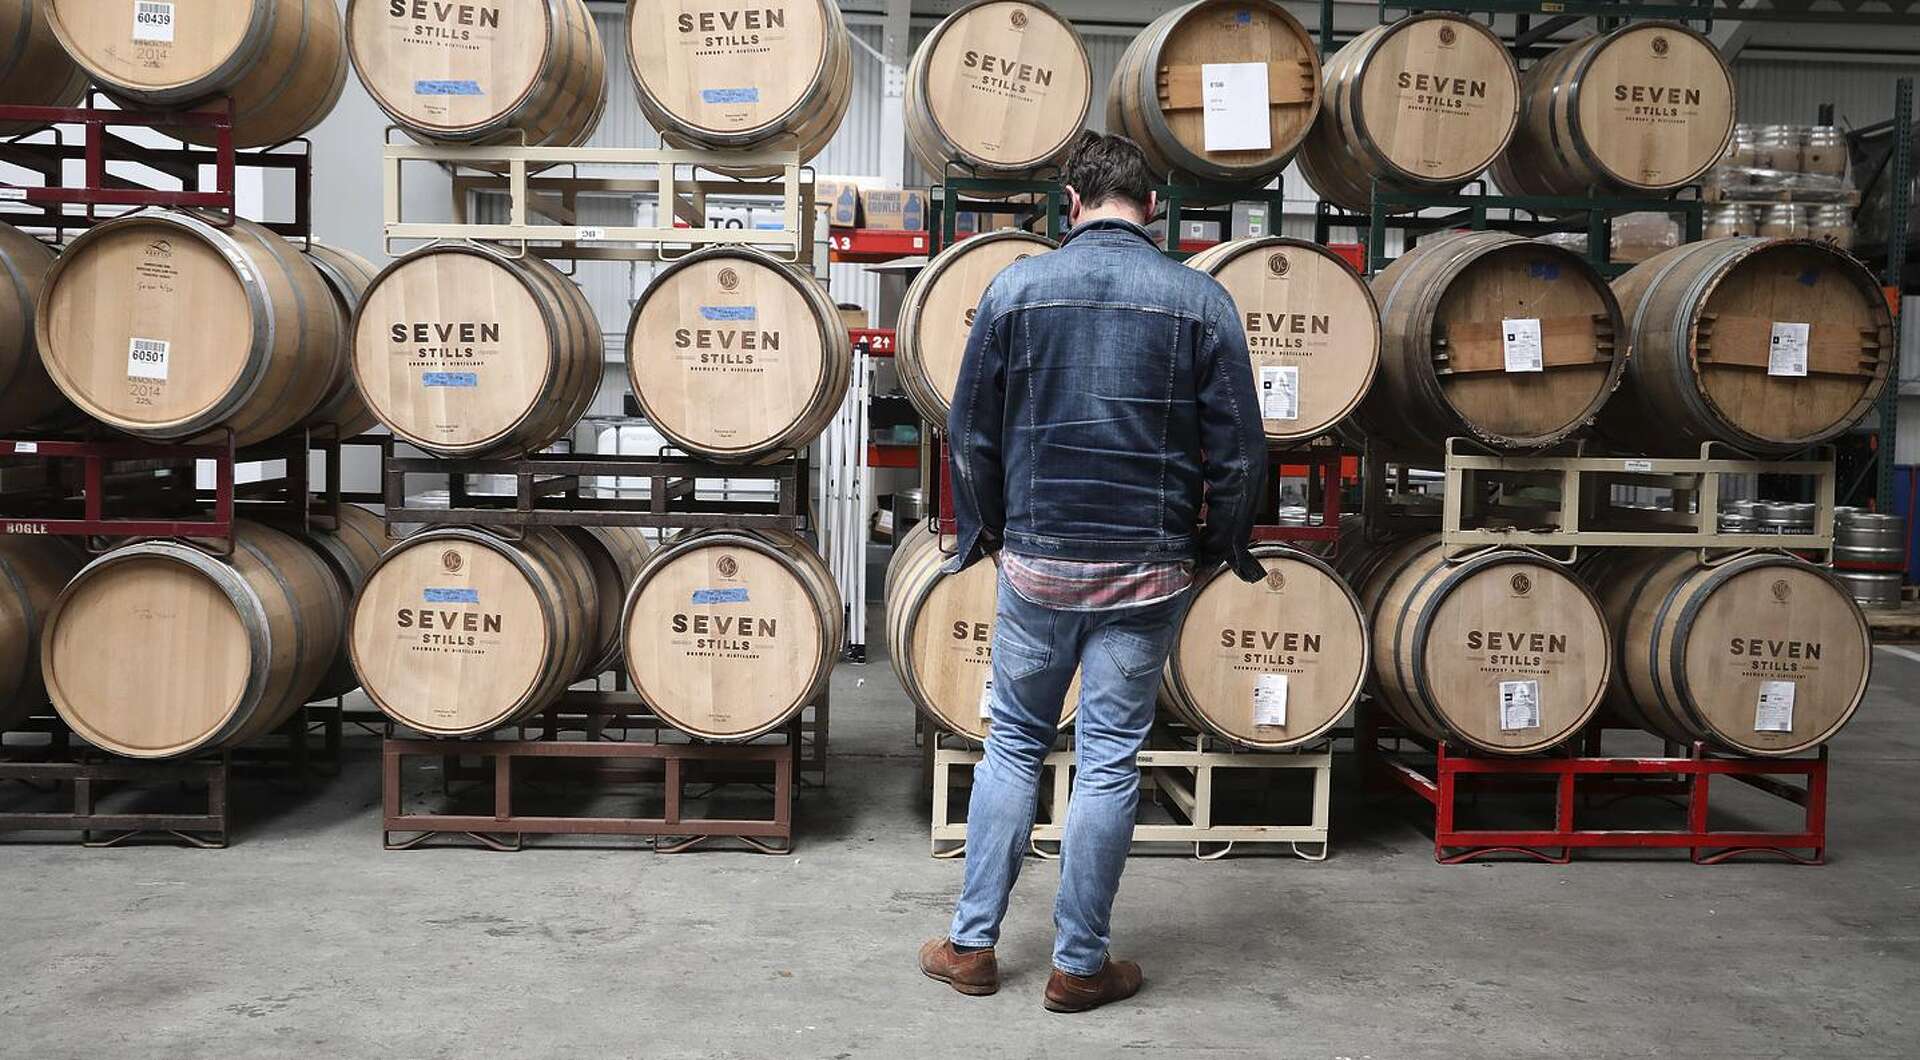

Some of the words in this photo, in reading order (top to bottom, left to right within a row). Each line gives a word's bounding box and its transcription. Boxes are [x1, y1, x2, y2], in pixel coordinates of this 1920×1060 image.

[138, 12, 171, 25] 60439
[389, 0, 500, 28] SEVEN
[678, 9, 785, 33] SEVEN
[414, 25, 470, 40] STILLS
[705, 35, 760, 47] STILLS
[136, 48, 168, 60] 2014
[964, 51, 1053, 87] SEVEN
[982, 75, 1027, 93] STILLS
[1397, 71, 1487, 98] SEVEN
[1417, 94, 1463, 108] STILLS
[1614, 84, 1701, 106] SEVEN
[1634, 106, 1678, 117] STILLS
[829, 237, 838, 249] A
[841, 237, 851, 249] 3
[1246, 312, 1329, 334] EVEN
[391, 323, 499, 343] SEVEN
[675, 329, 779, 350] SEVEN
[872, 336, 882, 349] 2
[1249, 336, 1303, 348] STILLS
[133, 350, 164, 363] 60501
[418, 348, 473, 358] STILLS
[700, 353, 754, 364] STILLS
[129, 384, 161, 397] 2014
[6, 522, 49, 534] BOGLE
[397, 609, 502, 633] SEVEN
[672, 613, 776, 637] SEVEN
[422, 633, 475, 646] STILLS
[697, 638, 750, 650] STILLS
[1221, 629, 1321, 653] SEVEN
[1467, 630, 1567, 653] SEVEN
[1730, 638, 1821, 660] SEVEN
[1244, 653, 1295, 665] STILLS
[1490, 654, 1541, 666] STILLS
[1751, 660, 1798, 672] STILLS
